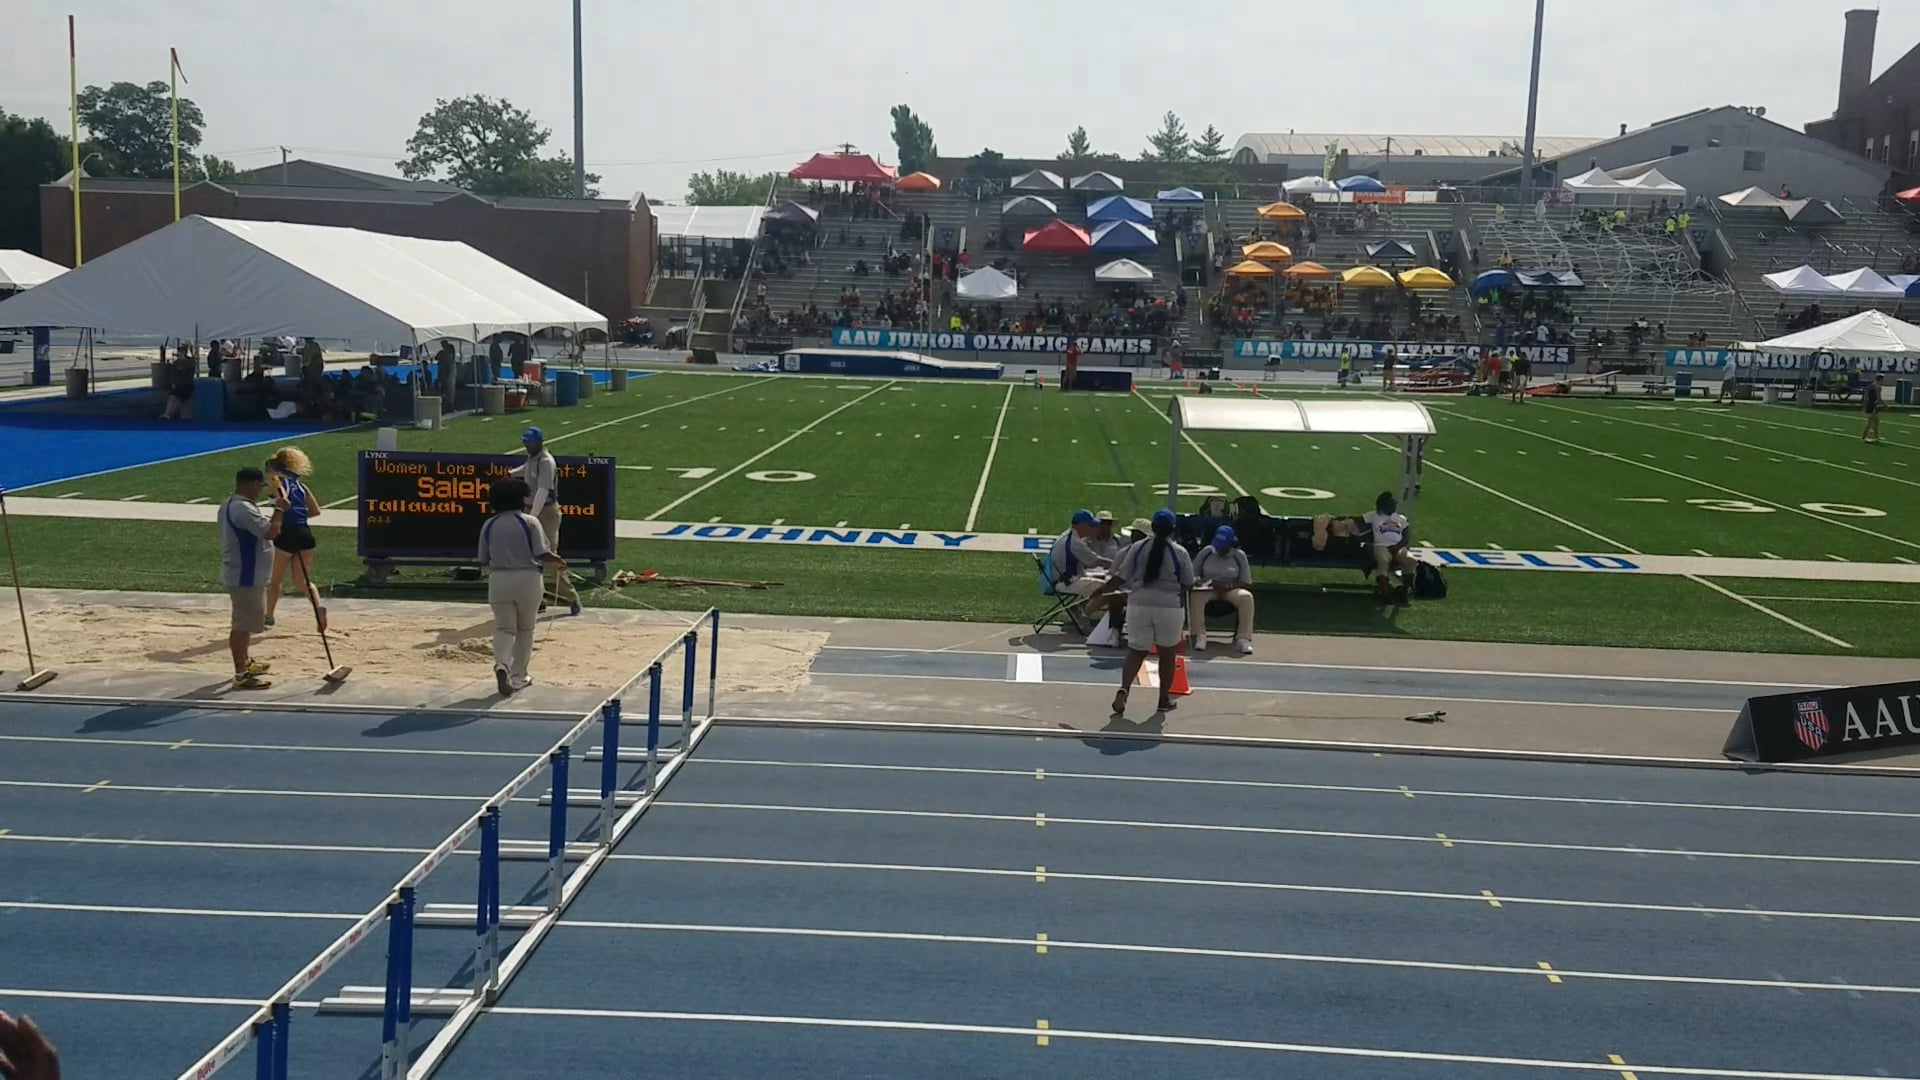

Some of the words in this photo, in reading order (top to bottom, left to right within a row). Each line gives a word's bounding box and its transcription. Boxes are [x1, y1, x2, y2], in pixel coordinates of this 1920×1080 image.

[839, 330, 881, 346] AAU
[888, 332, 966, 349] JUNIOR
[973, 334, 1067, 351] OLYMPIC
[1075, 337, 1152, 354] GAMES
[1240, 341, 1283, 356] AAU
[1291, 342, 1373, 358] JUNIOR
[1673, 350, 1719, 366] AAU
[365, 451, 388, 459] LYNX
[588, 457, 609, 465] LYNX
[375, 459, 427, 474] Women
[437, 461, 475, 476] Long
[365, 499, 464, 513] Tallawah
[652, 524, 978, 547] JOHNNY
[1800, 713, 1823, 739] USA
[1842, 695, 1920, 742] AAU
